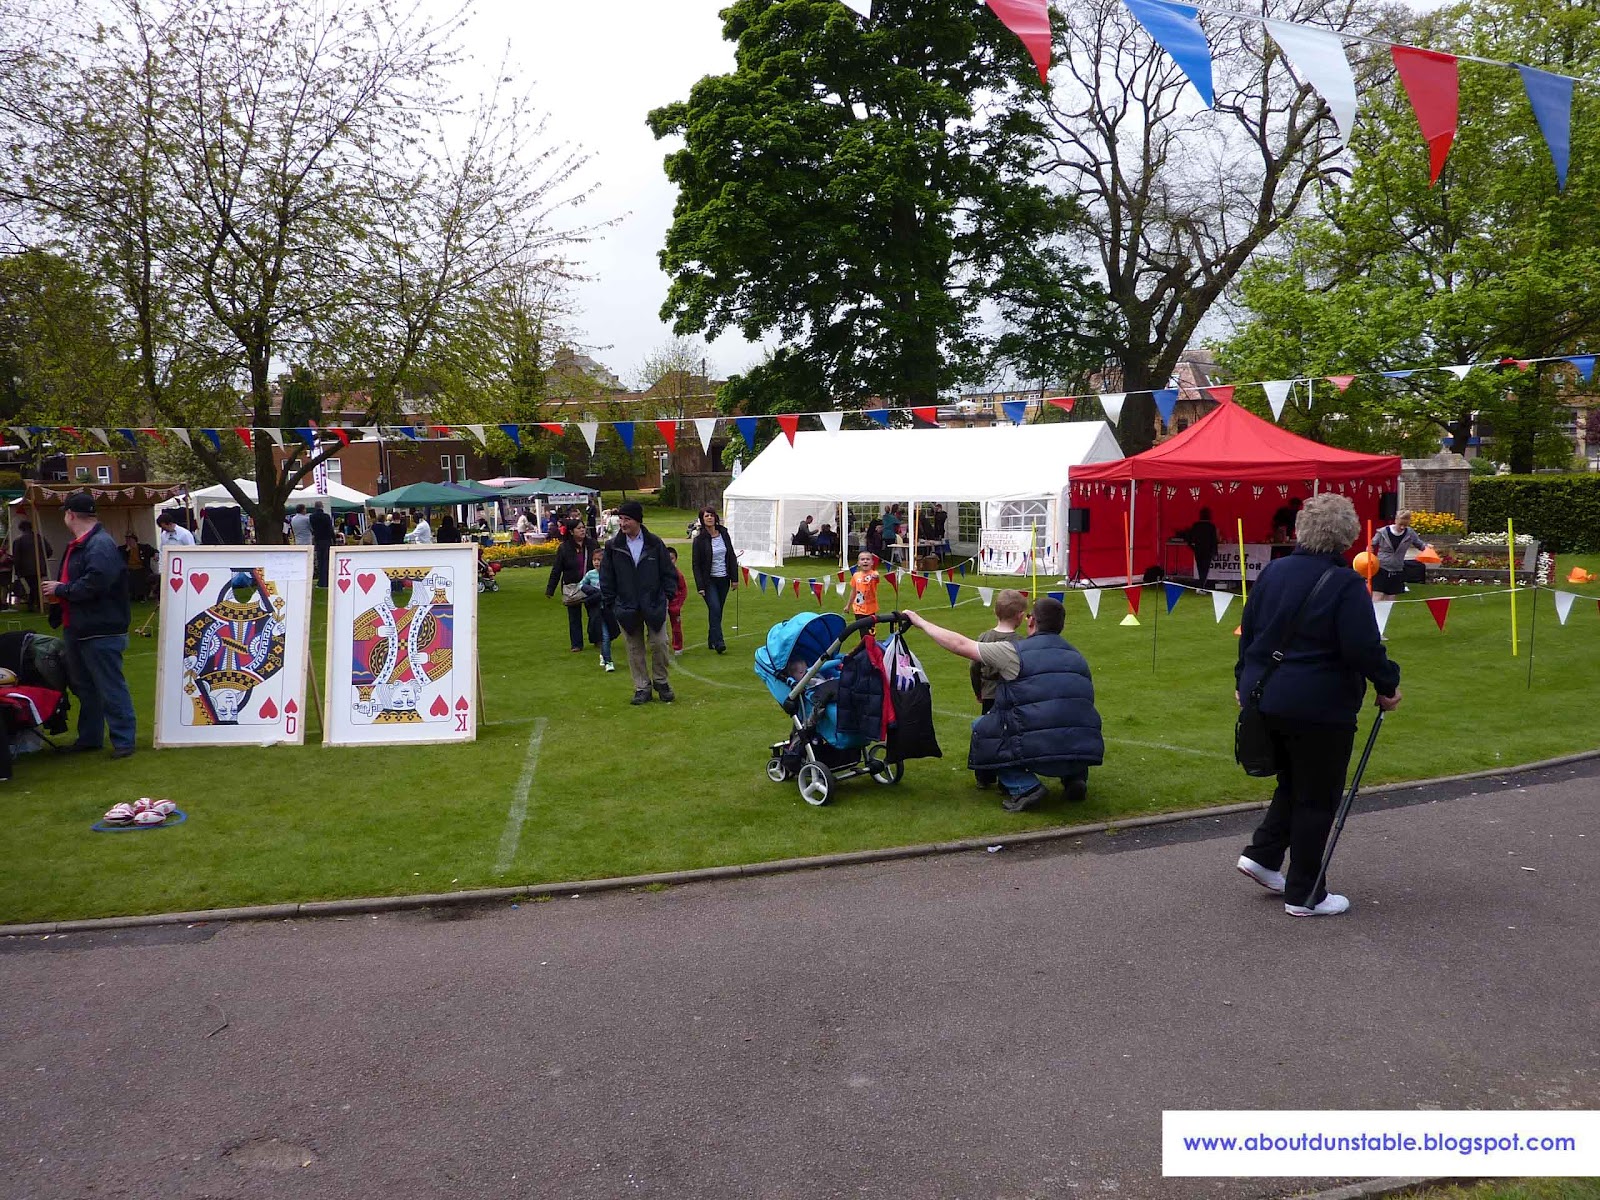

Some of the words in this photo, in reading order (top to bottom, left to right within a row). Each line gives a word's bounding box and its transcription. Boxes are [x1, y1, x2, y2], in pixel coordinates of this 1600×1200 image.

[172, 557, 182, 576] Q
[338, 558, 351, 576] K
[1208, 562, 1262, 571] OMPETIION
[286, 715, 296, 734] Q
[454, 713, 468, 731] K
